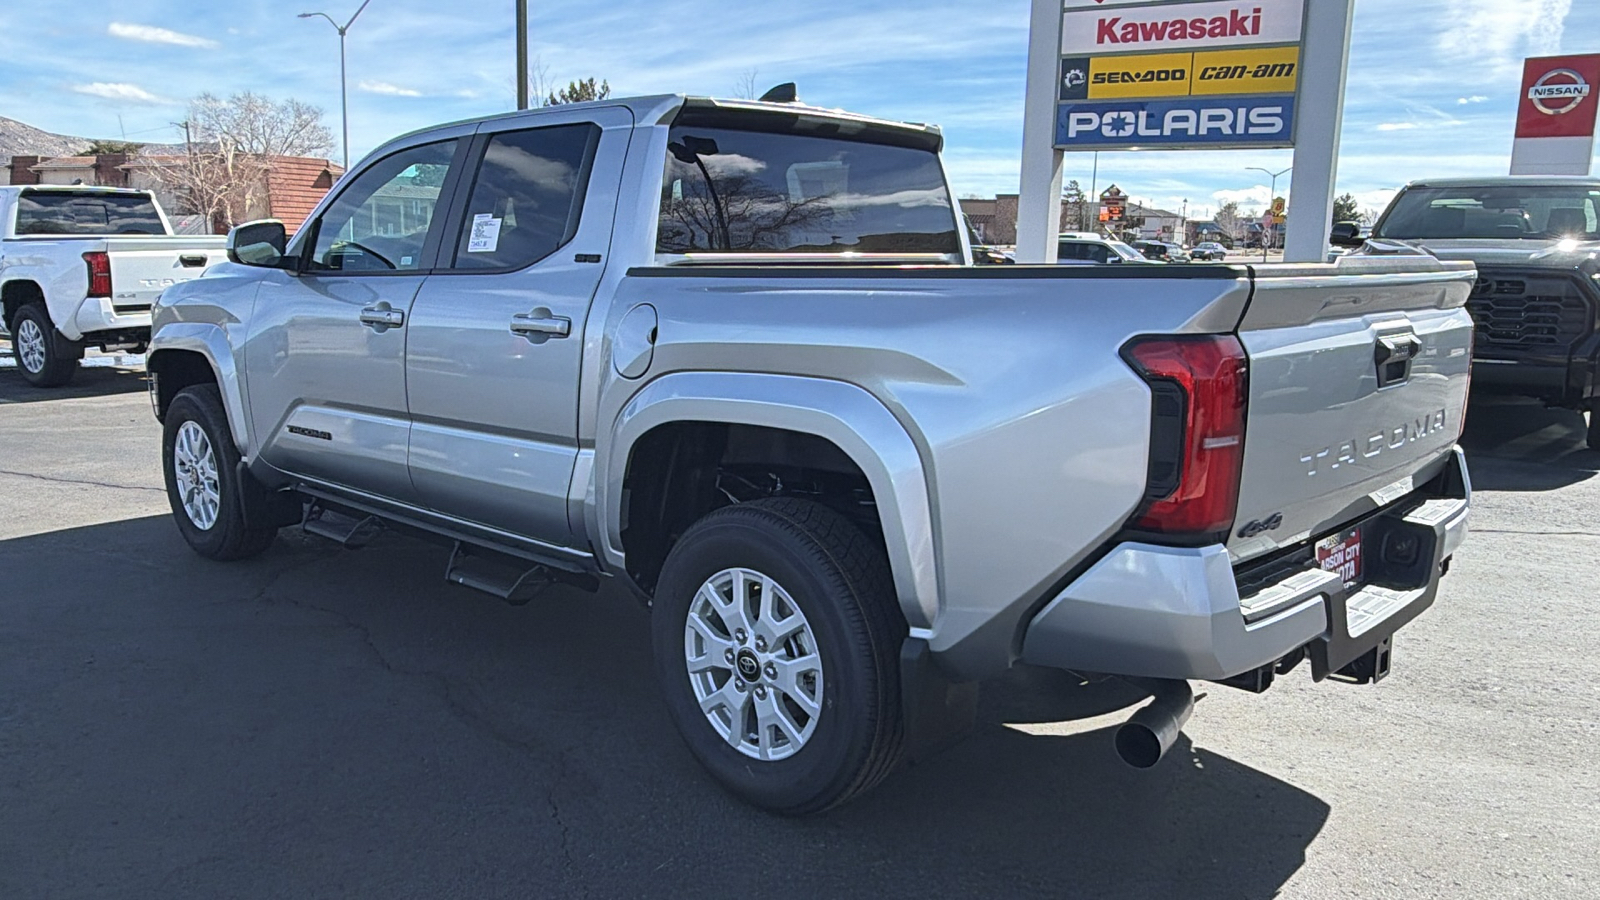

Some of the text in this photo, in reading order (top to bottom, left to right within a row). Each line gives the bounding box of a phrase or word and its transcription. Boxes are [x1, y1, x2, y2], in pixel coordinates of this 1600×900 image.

[1096, 8, 1262, 44] Kawasaki
[1199, 63, 1295, 80] can-am
[1534, 87, 1583, 96] NISSAN
[1068, 107, 1283, 138] POLARIS
[1300, 408, 1446, 476] TACOMA
[1321, 551, 1344, 571] ARSON
[1346, 542, 1360, 561] CITY
